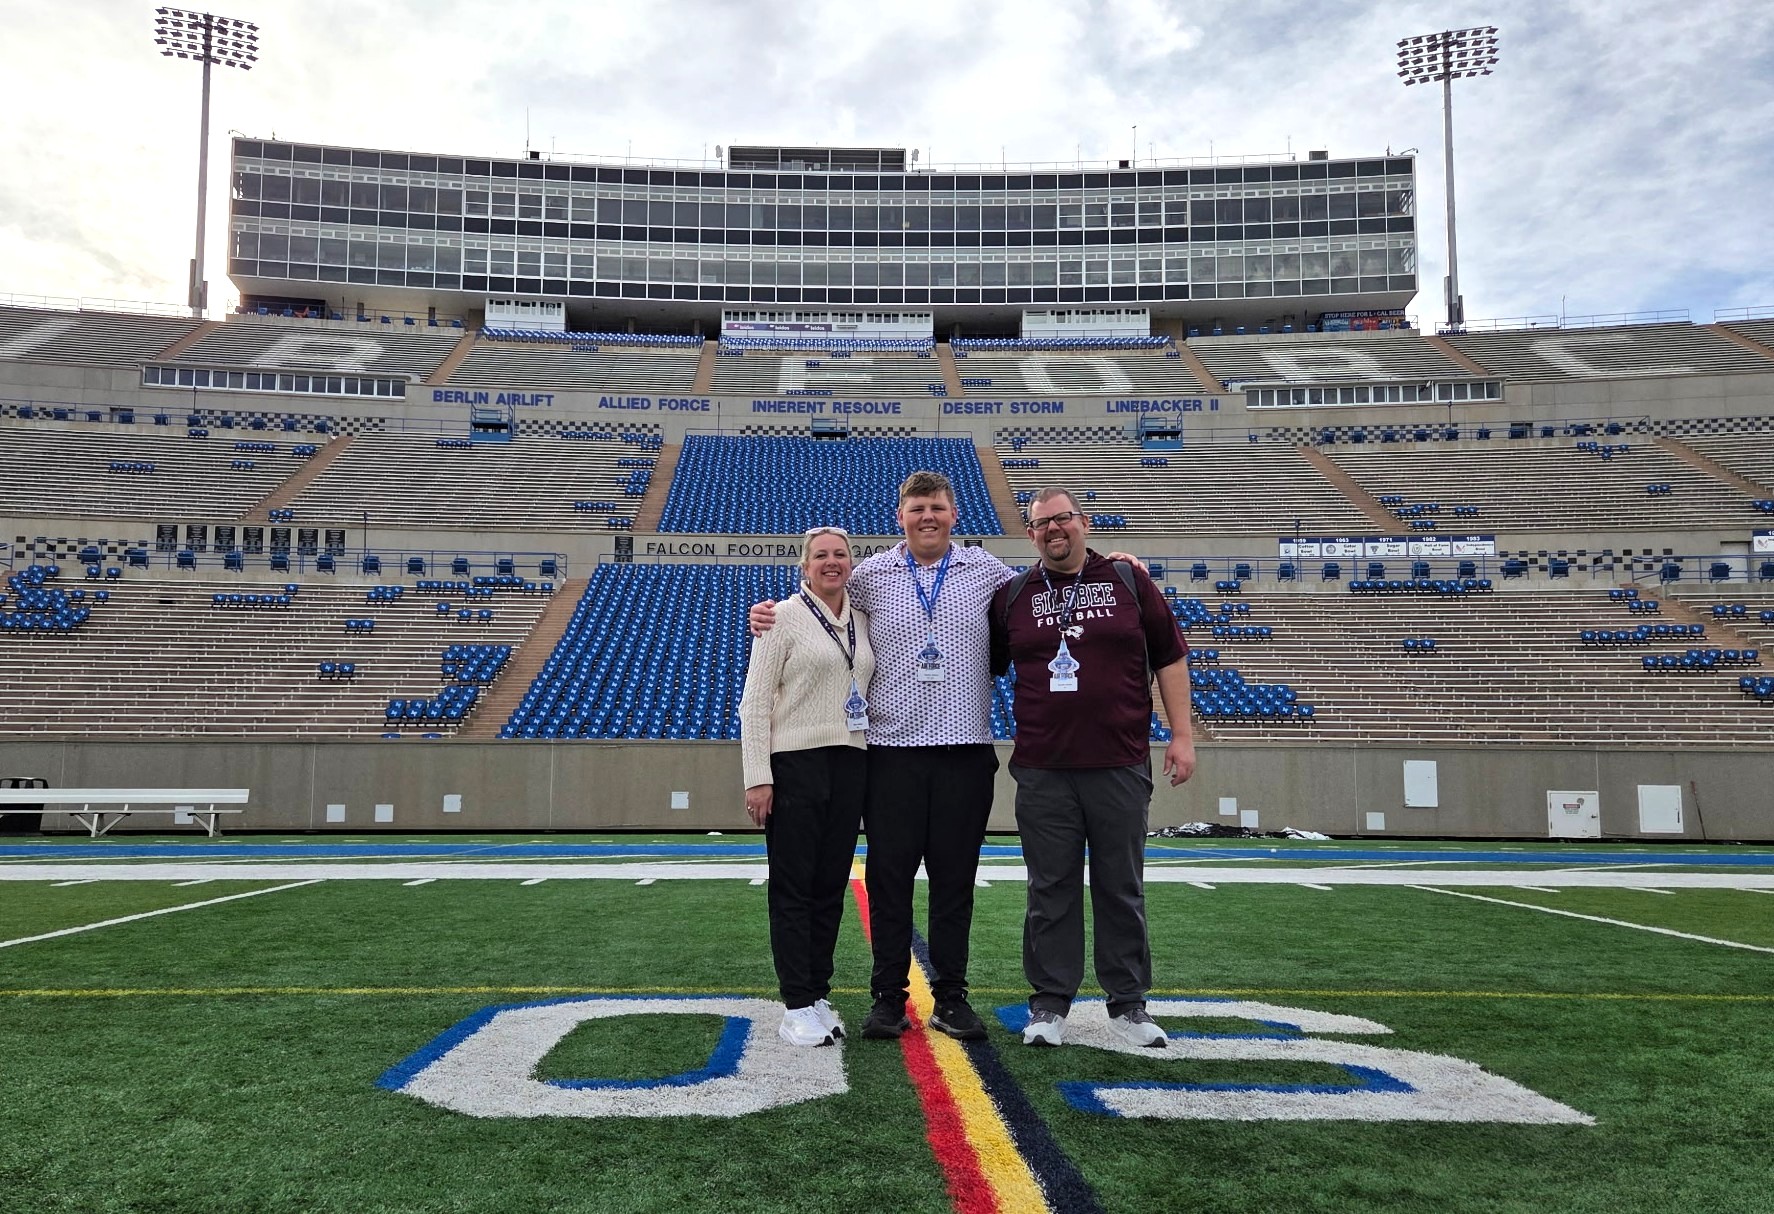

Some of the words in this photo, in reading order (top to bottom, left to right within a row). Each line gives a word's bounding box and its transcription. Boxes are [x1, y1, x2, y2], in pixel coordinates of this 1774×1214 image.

[433, 390, 489, 405] BERLIN
[496, 393, 554, 407] AIRLIFT
[599, 396, 651, 410] ALLIED
[658, 397, 710, 411] FORCE
[1106, 399, 1203, 413] LINEBACKER
[1210, 398, 1219, 411] II
[752, 400, 826, 414] INHERENT
[832, 401, 901, 414] RESOLVE
[943, 401, 1004, 414] DESERT
[1010, 401, 1064, 414] STORM
[646, 542, 715, 555] FALCON
[1032, 583, 1116, 617] SILSBEE
